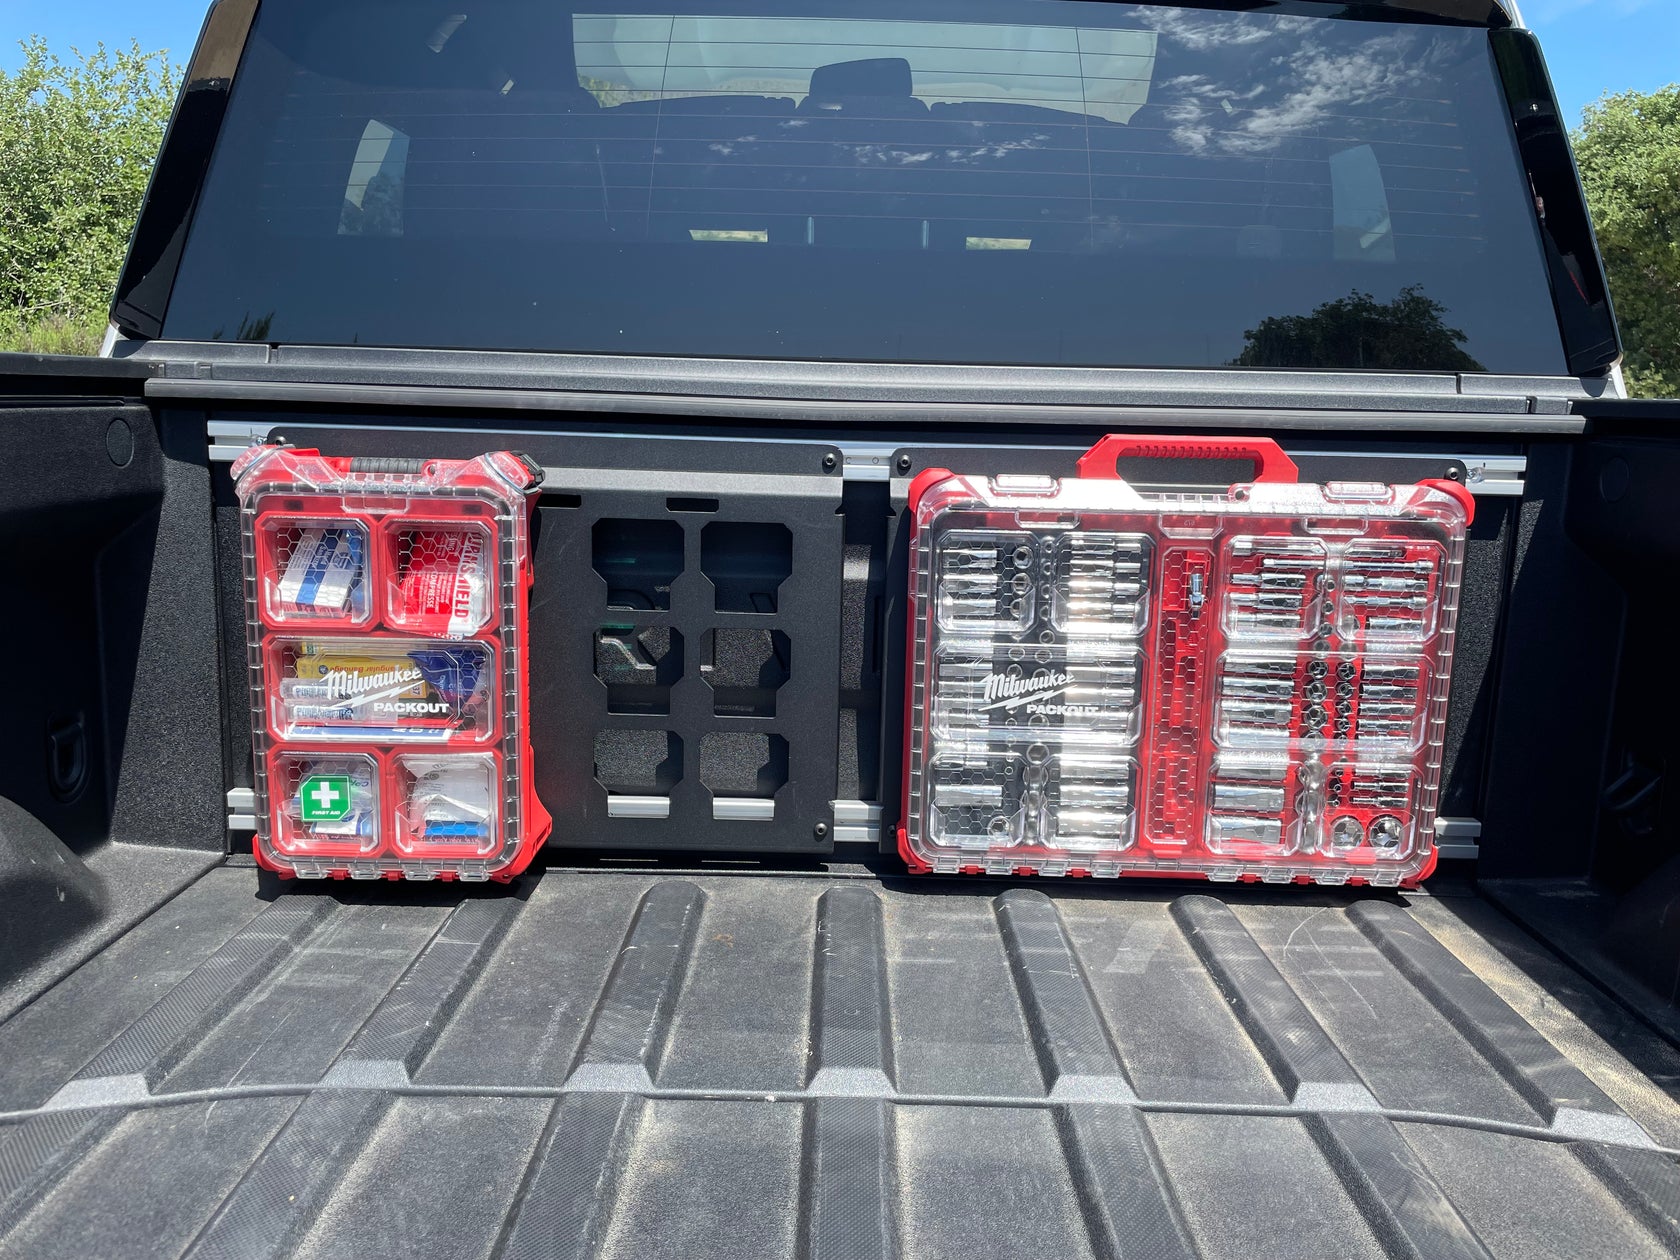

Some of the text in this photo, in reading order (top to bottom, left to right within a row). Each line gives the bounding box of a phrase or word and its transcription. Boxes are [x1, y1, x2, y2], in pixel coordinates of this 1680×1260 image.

[319, 665, 422, 700] Milwaukee
[979, 669, 1076, 702] Milwaukee
[373, 702, 450, 713] PACKOUT
[1026, 704, 1099, 715] PACKOUT
